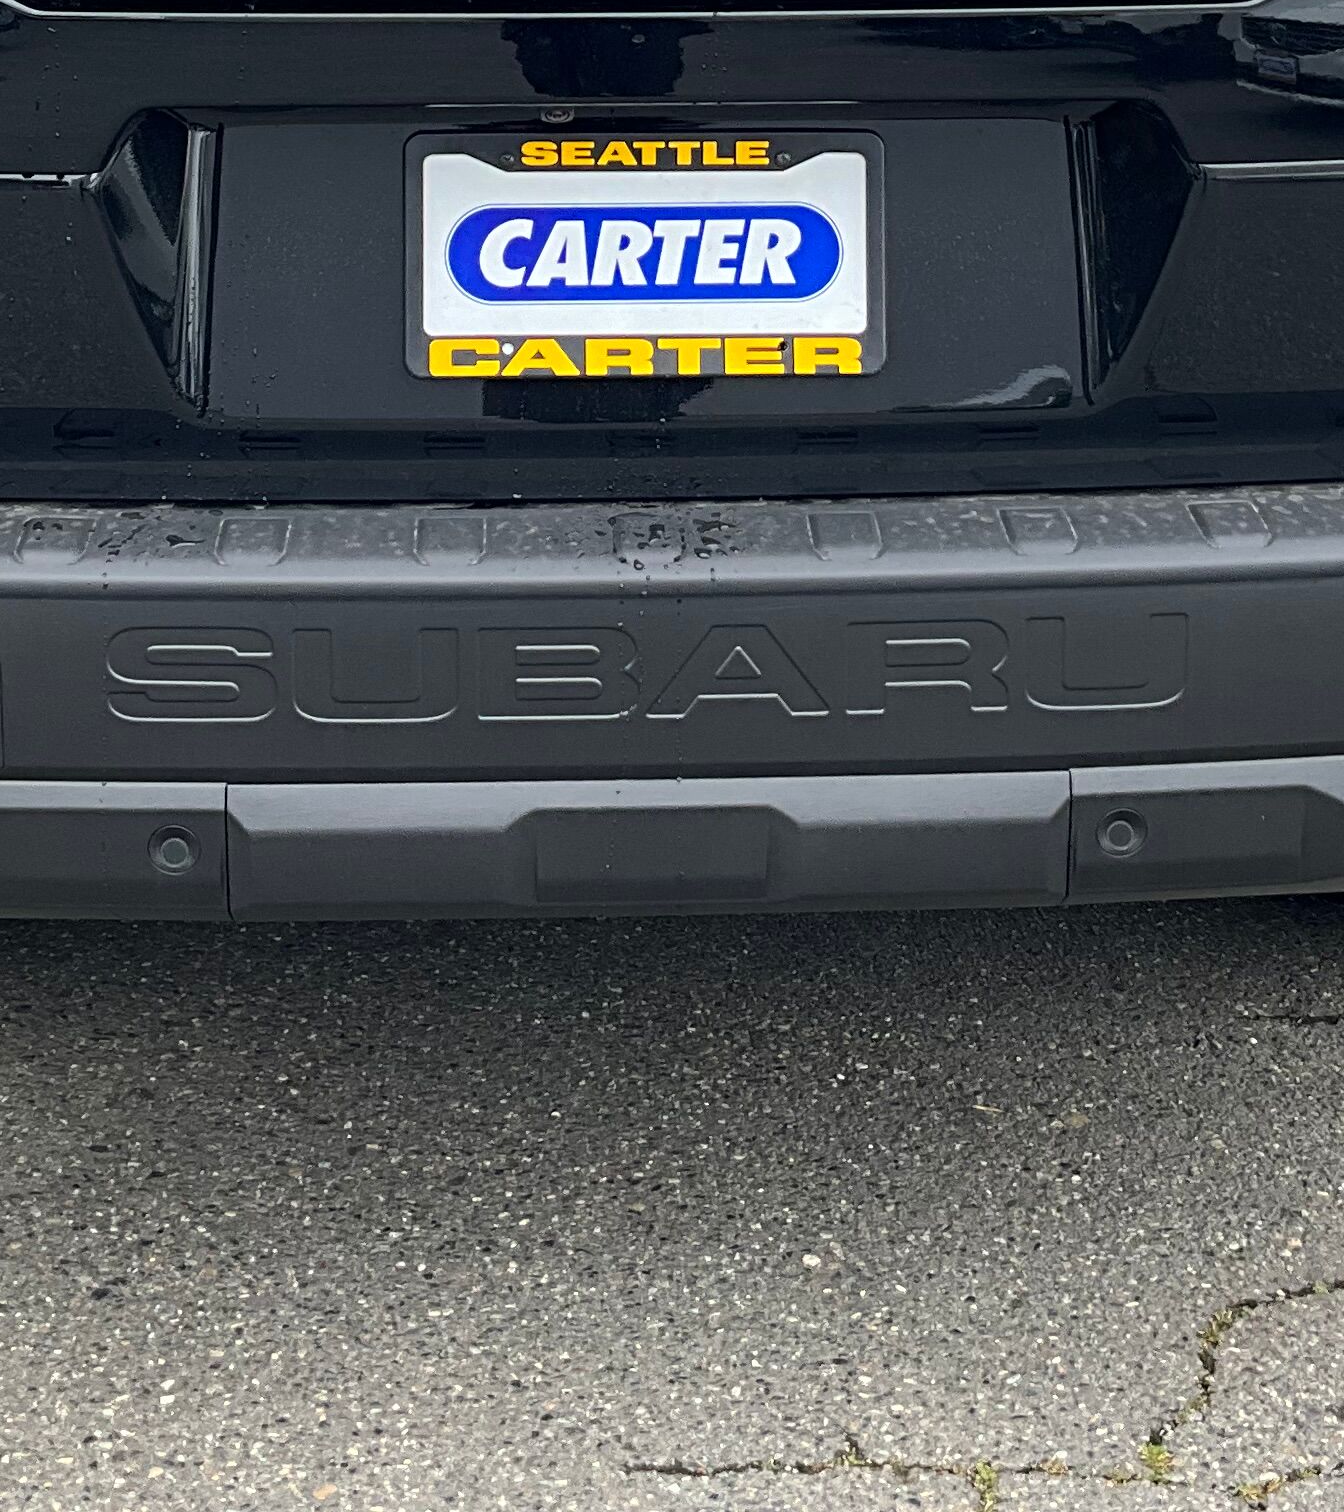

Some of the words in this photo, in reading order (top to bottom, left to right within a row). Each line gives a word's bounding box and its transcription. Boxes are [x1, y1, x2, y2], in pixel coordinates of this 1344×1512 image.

[520, 139, 770, 167] SEATTLE
[478, 218, 802, 289] CARTER
[428, 337, 864, 377] CARTER
[105, 612, 1190, 722] SUBARU
